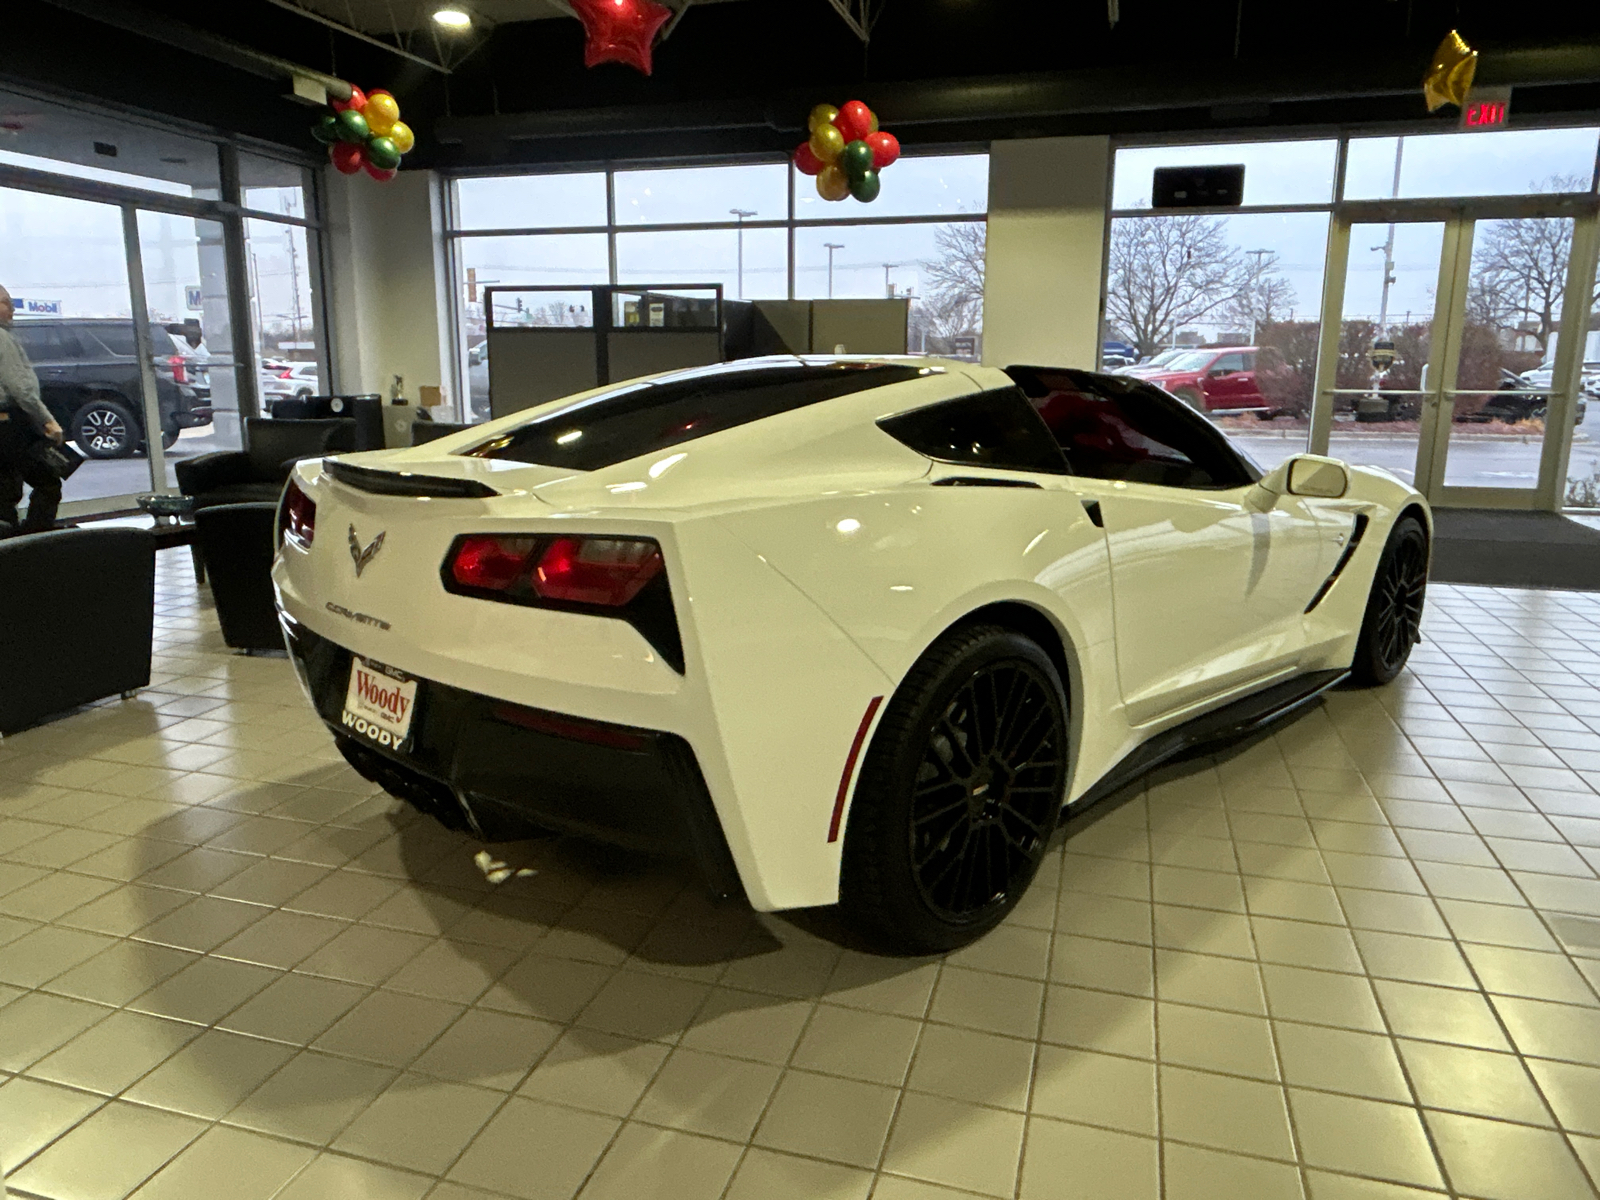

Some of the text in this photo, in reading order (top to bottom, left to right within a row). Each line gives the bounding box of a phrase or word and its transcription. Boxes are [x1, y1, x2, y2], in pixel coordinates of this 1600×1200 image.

[1466, 102, 1506, 126] EXIT
[28, 301, 57, 313] Mobil
[325, 601, 391, 630] CORVETTE
[357, 669, 410, 723] Woody
[342, 710, 402, 750] WOODY
